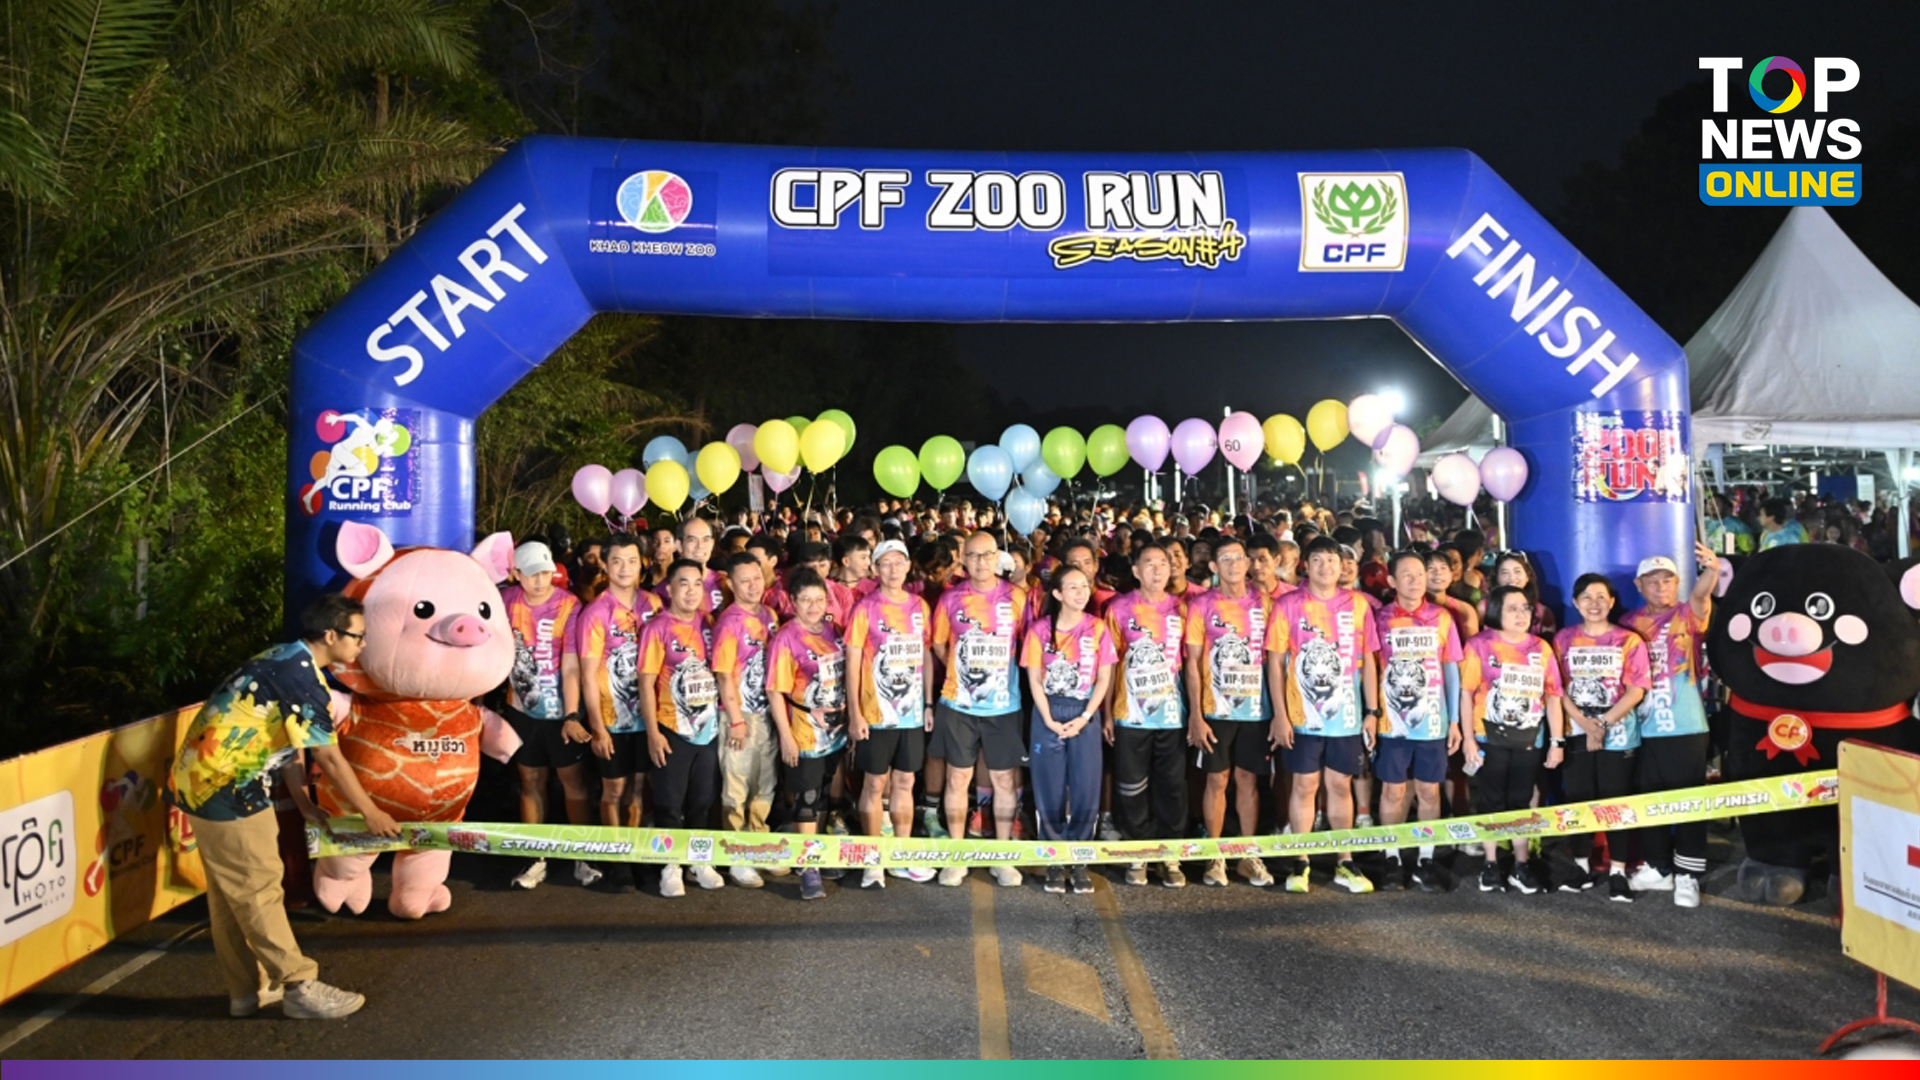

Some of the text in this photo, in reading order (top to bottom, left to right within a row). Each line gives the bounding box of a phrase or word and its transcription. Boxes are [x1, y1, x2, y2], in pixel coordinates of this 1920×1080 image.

[771, 167, 1229, 231] CPF ZOO RUN
[590, 239, 716, 257] KHAO KHEOW ZOO
[1322, 243, 1386, 263] CPF
[366, 202, 549, 387] START
[1446, 212, 1640, 398] FINISH
[1224, 439, 1241, 452] 60
[330, 477, 393, 500] CPF
[329, 499, 412, 514] Running Club
[1572, 654, 1614, 666] VIP-9051
[412, 736, 465, 757] หมูชีวา
[1646, 799, 1702, 816] START
[1714, 792, 1770, 809] FINISH
[501, 839, 563, 851] START
[573, 841, 634, 855] FINISH
[890, 851, 948, 861] START
[961, 851, 1021, 861] FINISH
